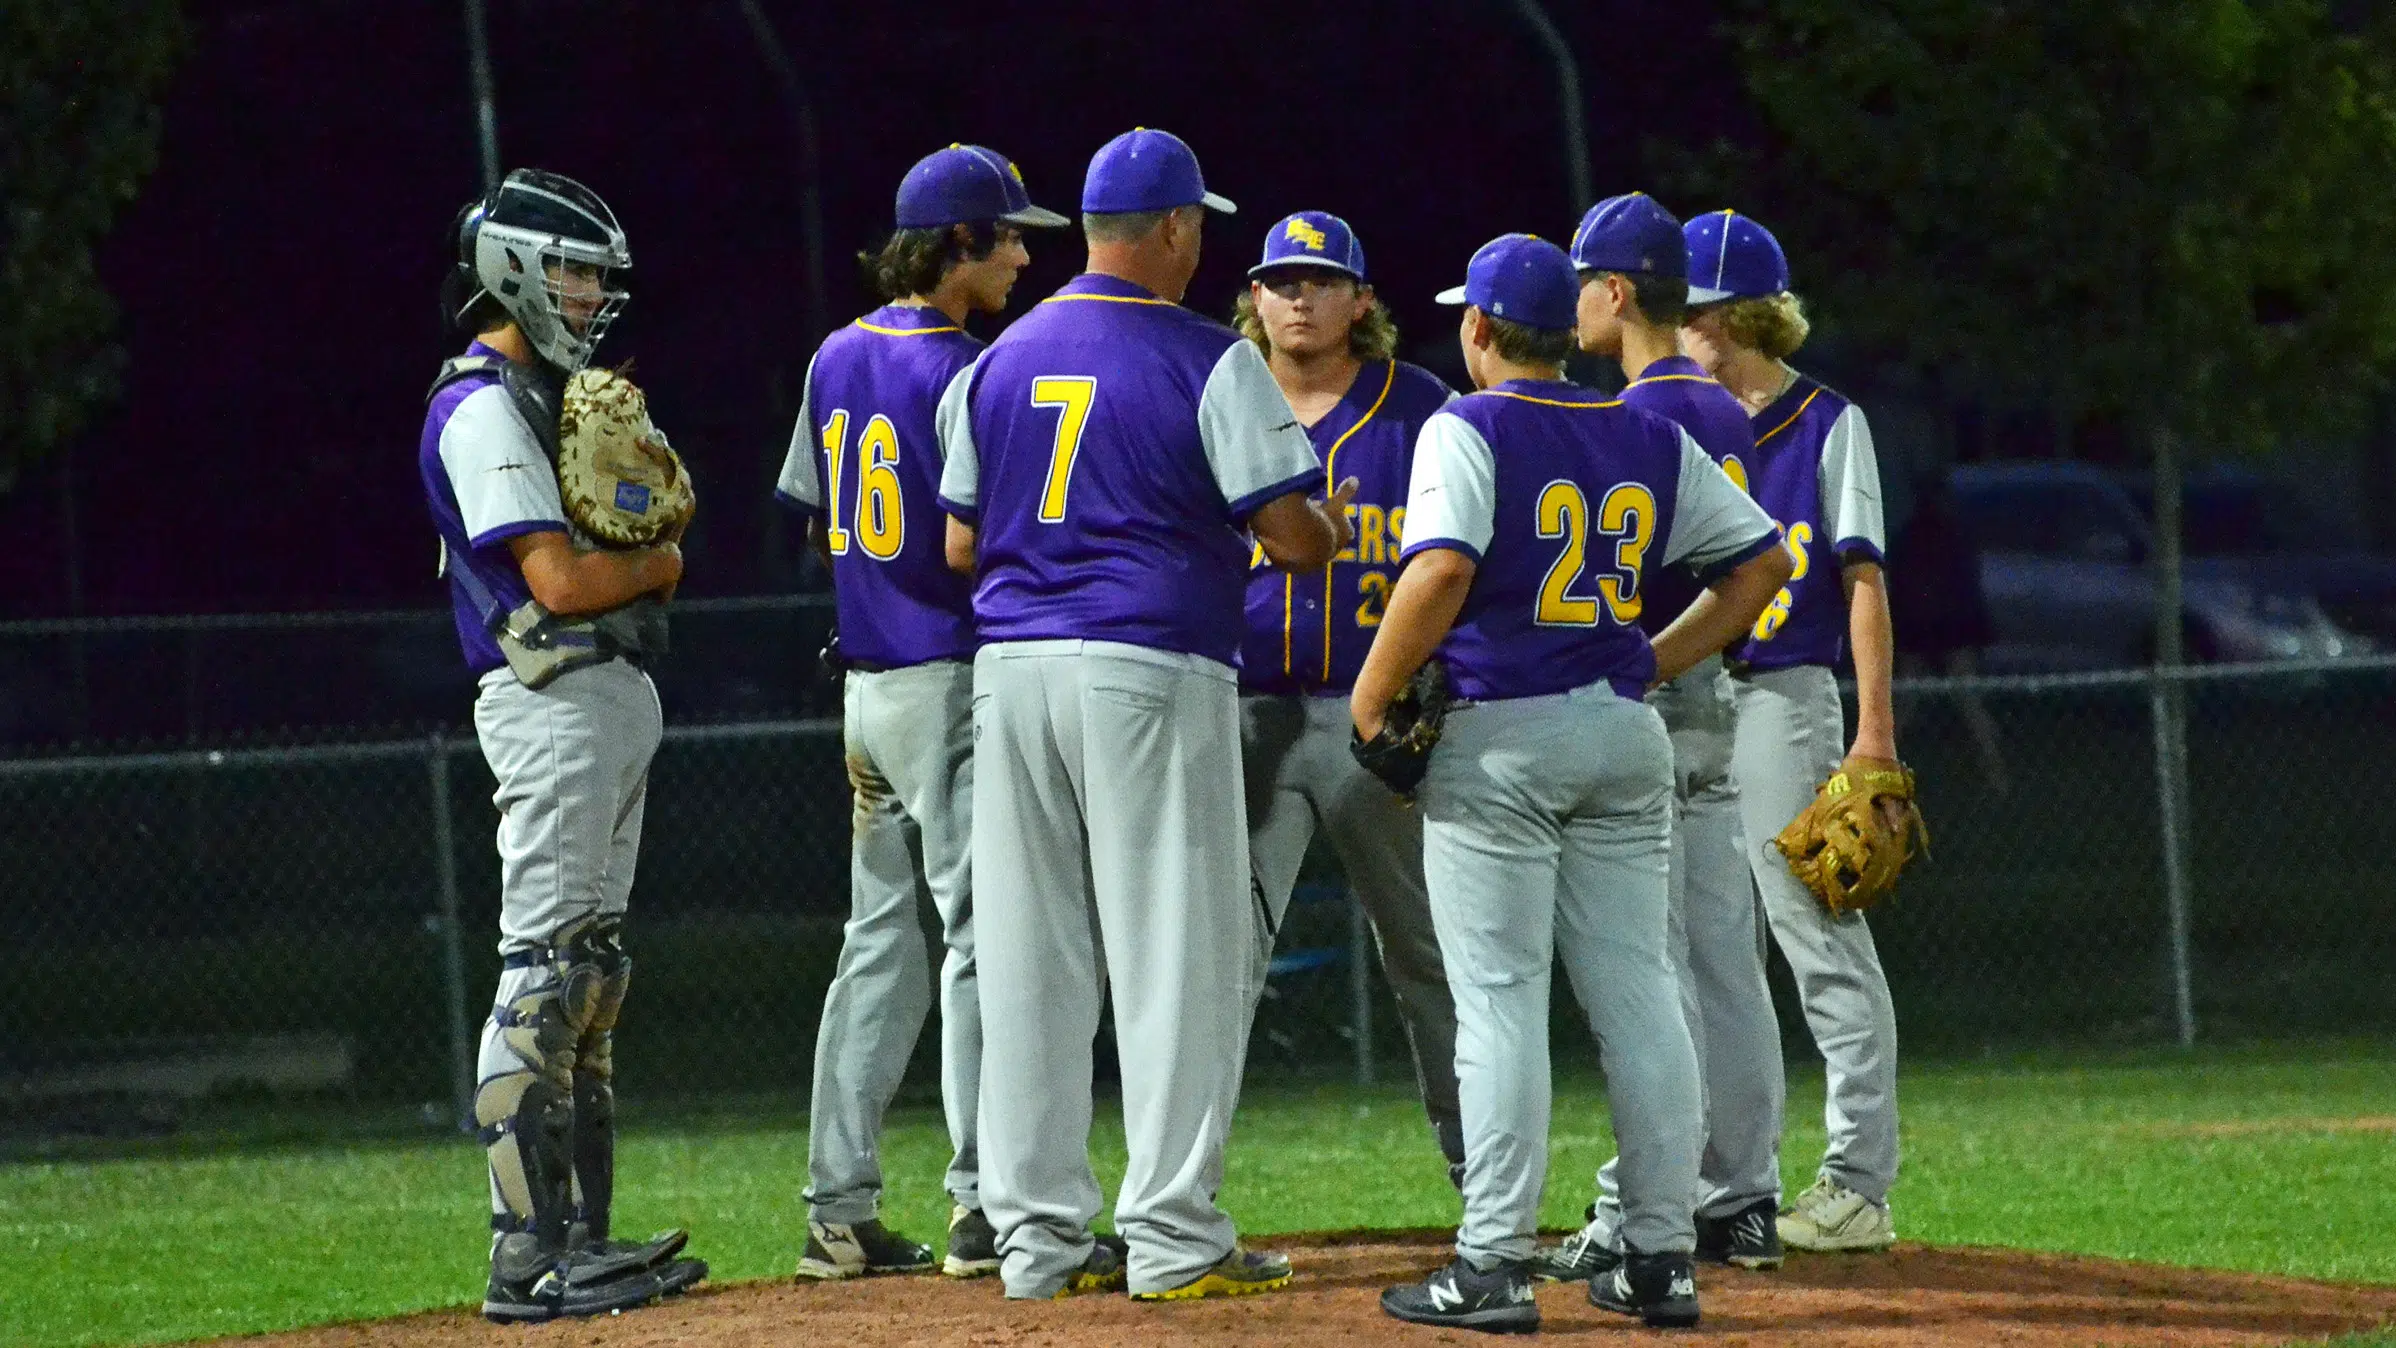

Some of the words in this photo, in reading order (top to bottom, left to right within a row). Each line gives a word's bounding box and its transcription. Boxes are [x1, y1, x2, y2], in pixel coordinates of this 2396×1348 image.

[822, 409, 904, 561] 16
[1031, 375, 1097, 523] 7
[1534, 478, 1657, 626] 23
